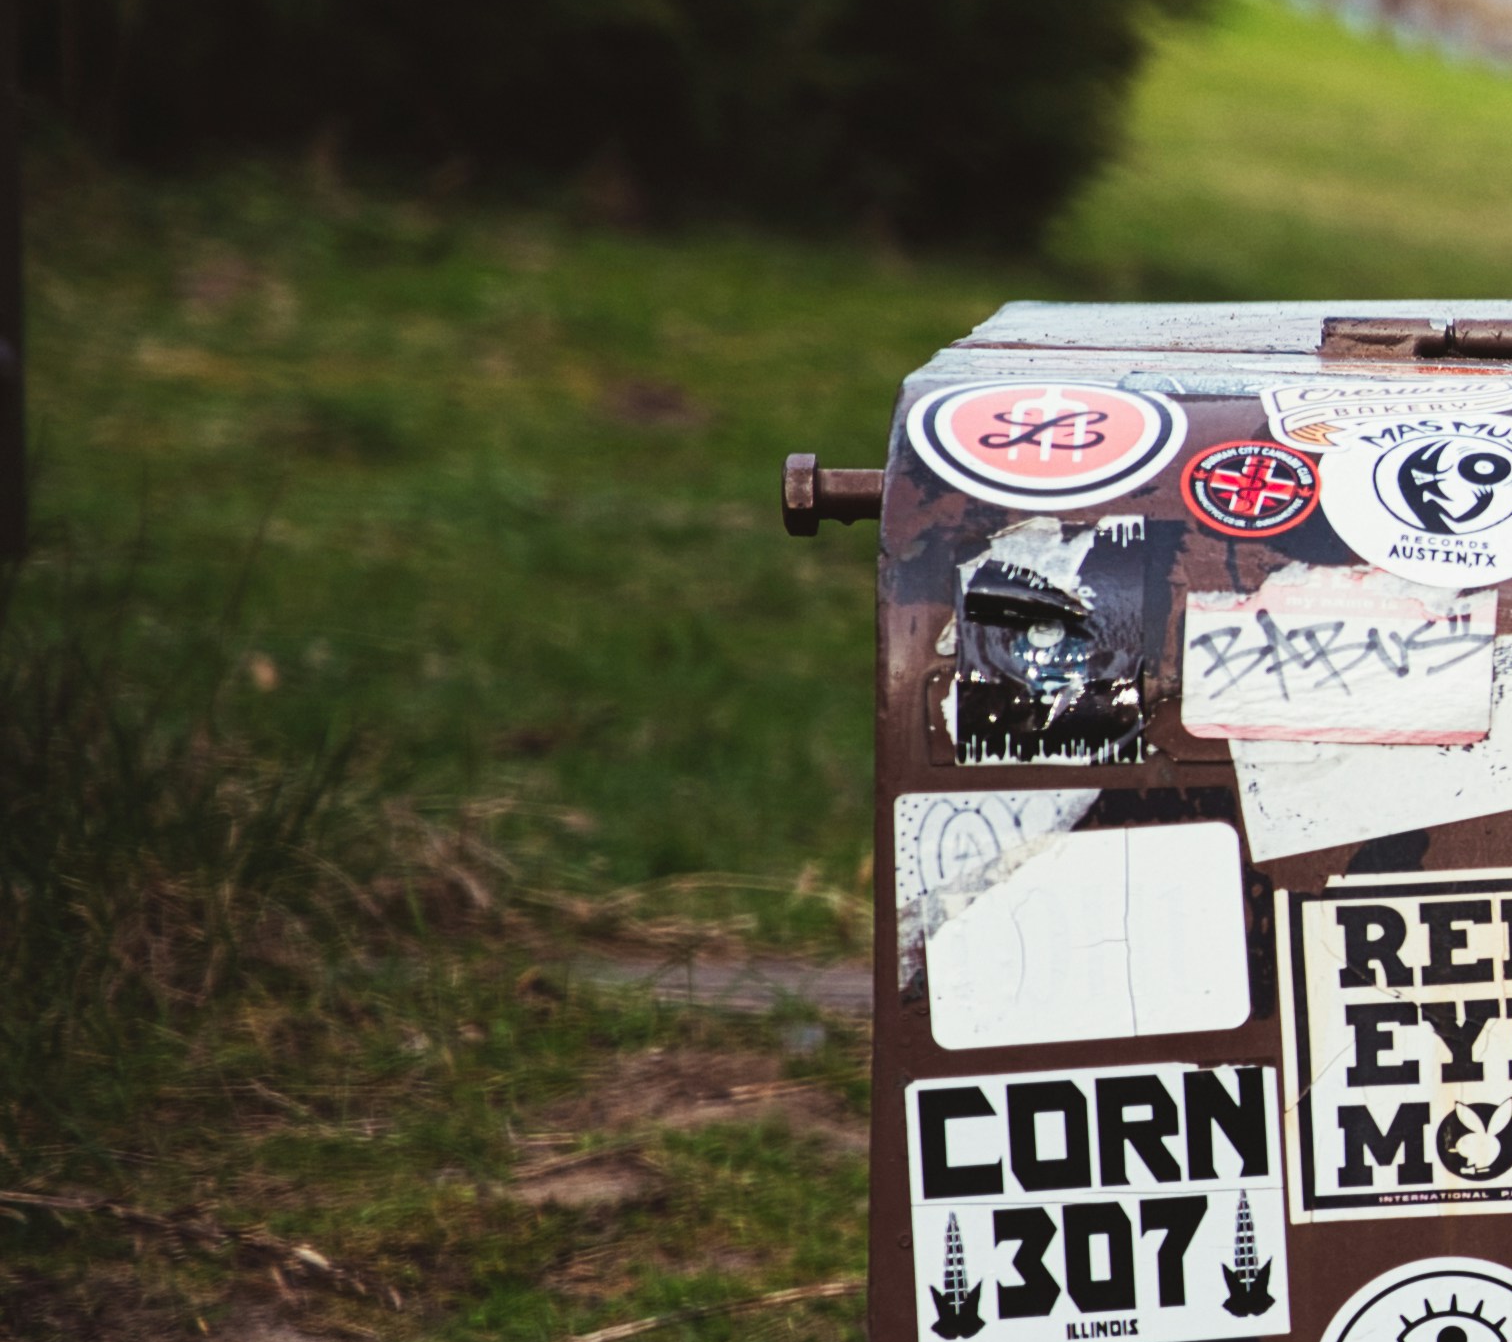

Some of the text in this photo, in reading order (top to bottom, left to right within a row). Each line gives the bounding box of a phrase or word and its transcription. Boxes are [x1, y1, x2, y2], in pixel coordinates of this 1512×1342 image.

[1334, 401, 1468, 417] BAKERY
[1360, 420, 1443, 449] MAS
[1400, 534, 1490, 549] RECORDS
[917, 1067, 1269, 1199] CORN
[1378, 1191, 1490, 1204] INTERNATIONAL
[992, 1195, 1208, 1321] 307
[1066, 1318, 1140, 1341] ILLINOIS
